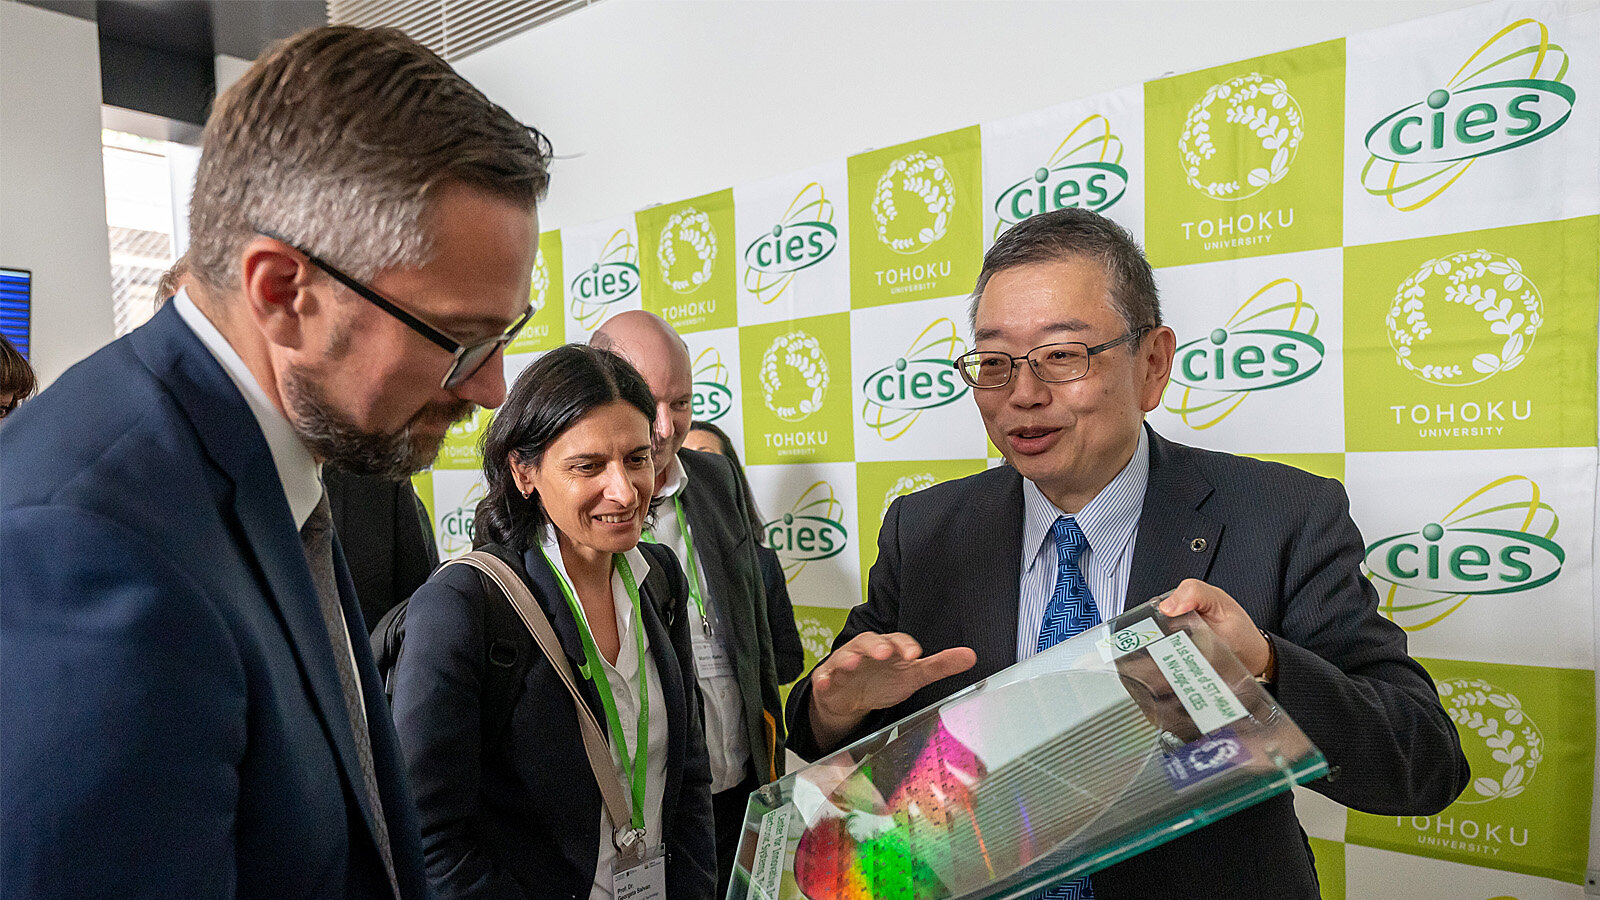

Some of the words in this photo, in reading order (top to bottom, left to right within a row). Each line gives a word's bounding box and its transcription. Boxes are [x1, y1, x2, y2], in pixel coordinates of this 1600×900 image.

[1388, 89, 1543, 156] cies
[1011, 167, 1107, 219] cies
[1181, 208, 1295, 241] TOHOKU
[756, 223, 823, 267] cies
[1203, 234, 1272, 251] UNIVERSITY
[580, 262, 630, 297] cies
[874, 260, 951, 287] TOHOKU
[890, 281, 937, 295] UNIVERSITY
[662, 299, 716, 320] TOHOKU
[520, 325, 549, 339] HOKU
[1181, 327, 1299, 382] cies
[876, 357, 955, 401] cies
[692, 391, 720, 415] es
[1390, 400, 1532, 425] TOHOKU
[764, 431, 828, 447] TOHOKU
[1419, 425, 1504, 438] UNIVERSITY
[448, 507, 475, 536] cie
[769, 513, 834, 552] cies
[1386, 522, 1533, 583] cies
[1117, 632, 1137, 650] cies
[1169, 634, 1182, 648] The
[1175, 645, 1190, 656] 1st
[1165, 659, 1190, 687] NV-Logic
[1182, 654, 1205, 677] Sample
[1183, 685, 1196, 696] at
[1188, 692, 1209, 711] CIES
[1203, 682, 1236, 718] STT-MRAM
[776, 813, 787, 835] Center
[1418, 835, 1500, 855] UNIVERSITY
